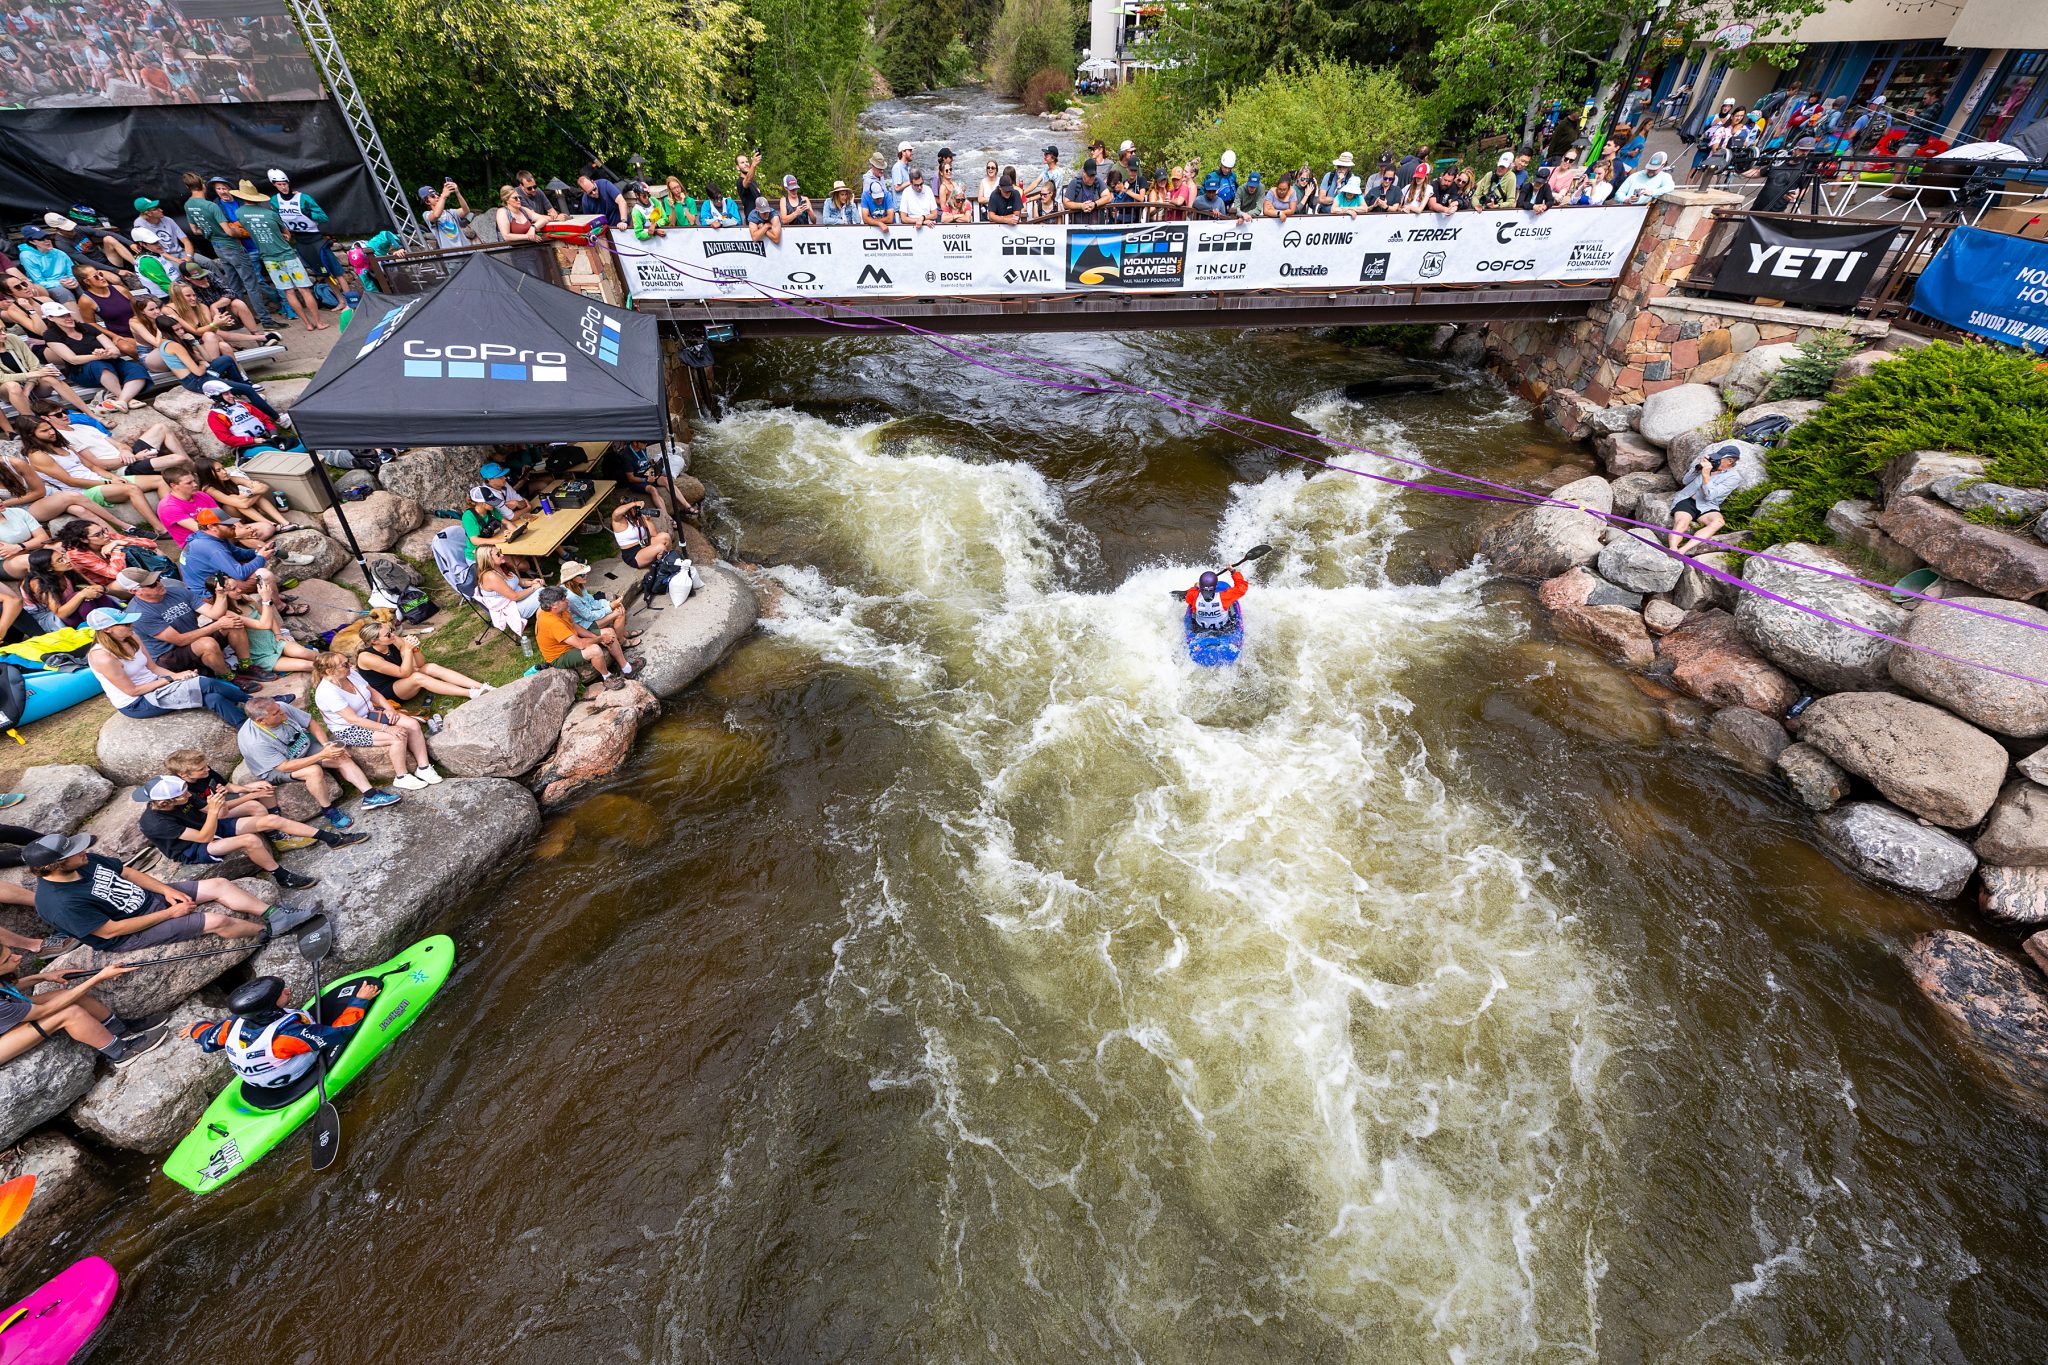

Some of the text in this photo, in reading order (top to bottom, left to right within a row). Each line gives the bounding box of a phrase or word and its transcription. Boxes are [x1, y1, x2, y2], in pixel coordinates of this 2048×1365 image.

[1125, 231, 1185, 243] GoPro
[1199, 231, 1253, 242] GoPro
[1407, 227, 1463, 242] TERREX
[1514, 227, 1552, 237] CELSIUS
[862, 238, 913, 251] GMC
[1001, 235, 1056, 246] GoPro
[1305, 231, 1354, 246] GO RVING
[704, 241, 766, 257] NATURE VALLEY
[795, 242, 832, 255] YETI
[943, 240, 973, 252] VAIL
[1586, 244, 1603, 252] VAIL
[1123, 257, 1177, 266] MOUNTAIN
[1583, 251, 1614, 260] VALLEY
[1476, 259, 1536, 271] OOFOS
[1567, 259, 1611, 267] FOUNDATION
[1747, 242, 1864, 283] YETI
[649, 265, 668, 273] VAIL
[1123, 265, 1177, 276] GAMES
[1196, 263, 1246, 275] TINCUP
[1279, 262, 1329, 277] Outside
[940, 272, 972, 281] BOSCH
[1019, 269, 1051, 283] VAIL
[2016, 284, 2048, 307] HO
[1968, 310, 2007, 332] SAVOR
[2002, 318, 2029, 338] THE
[576, 305, 602, 356] GoPro
[403, 340, 567, 365] GoPro
[221, 1138, 245, 1170] ROCK
